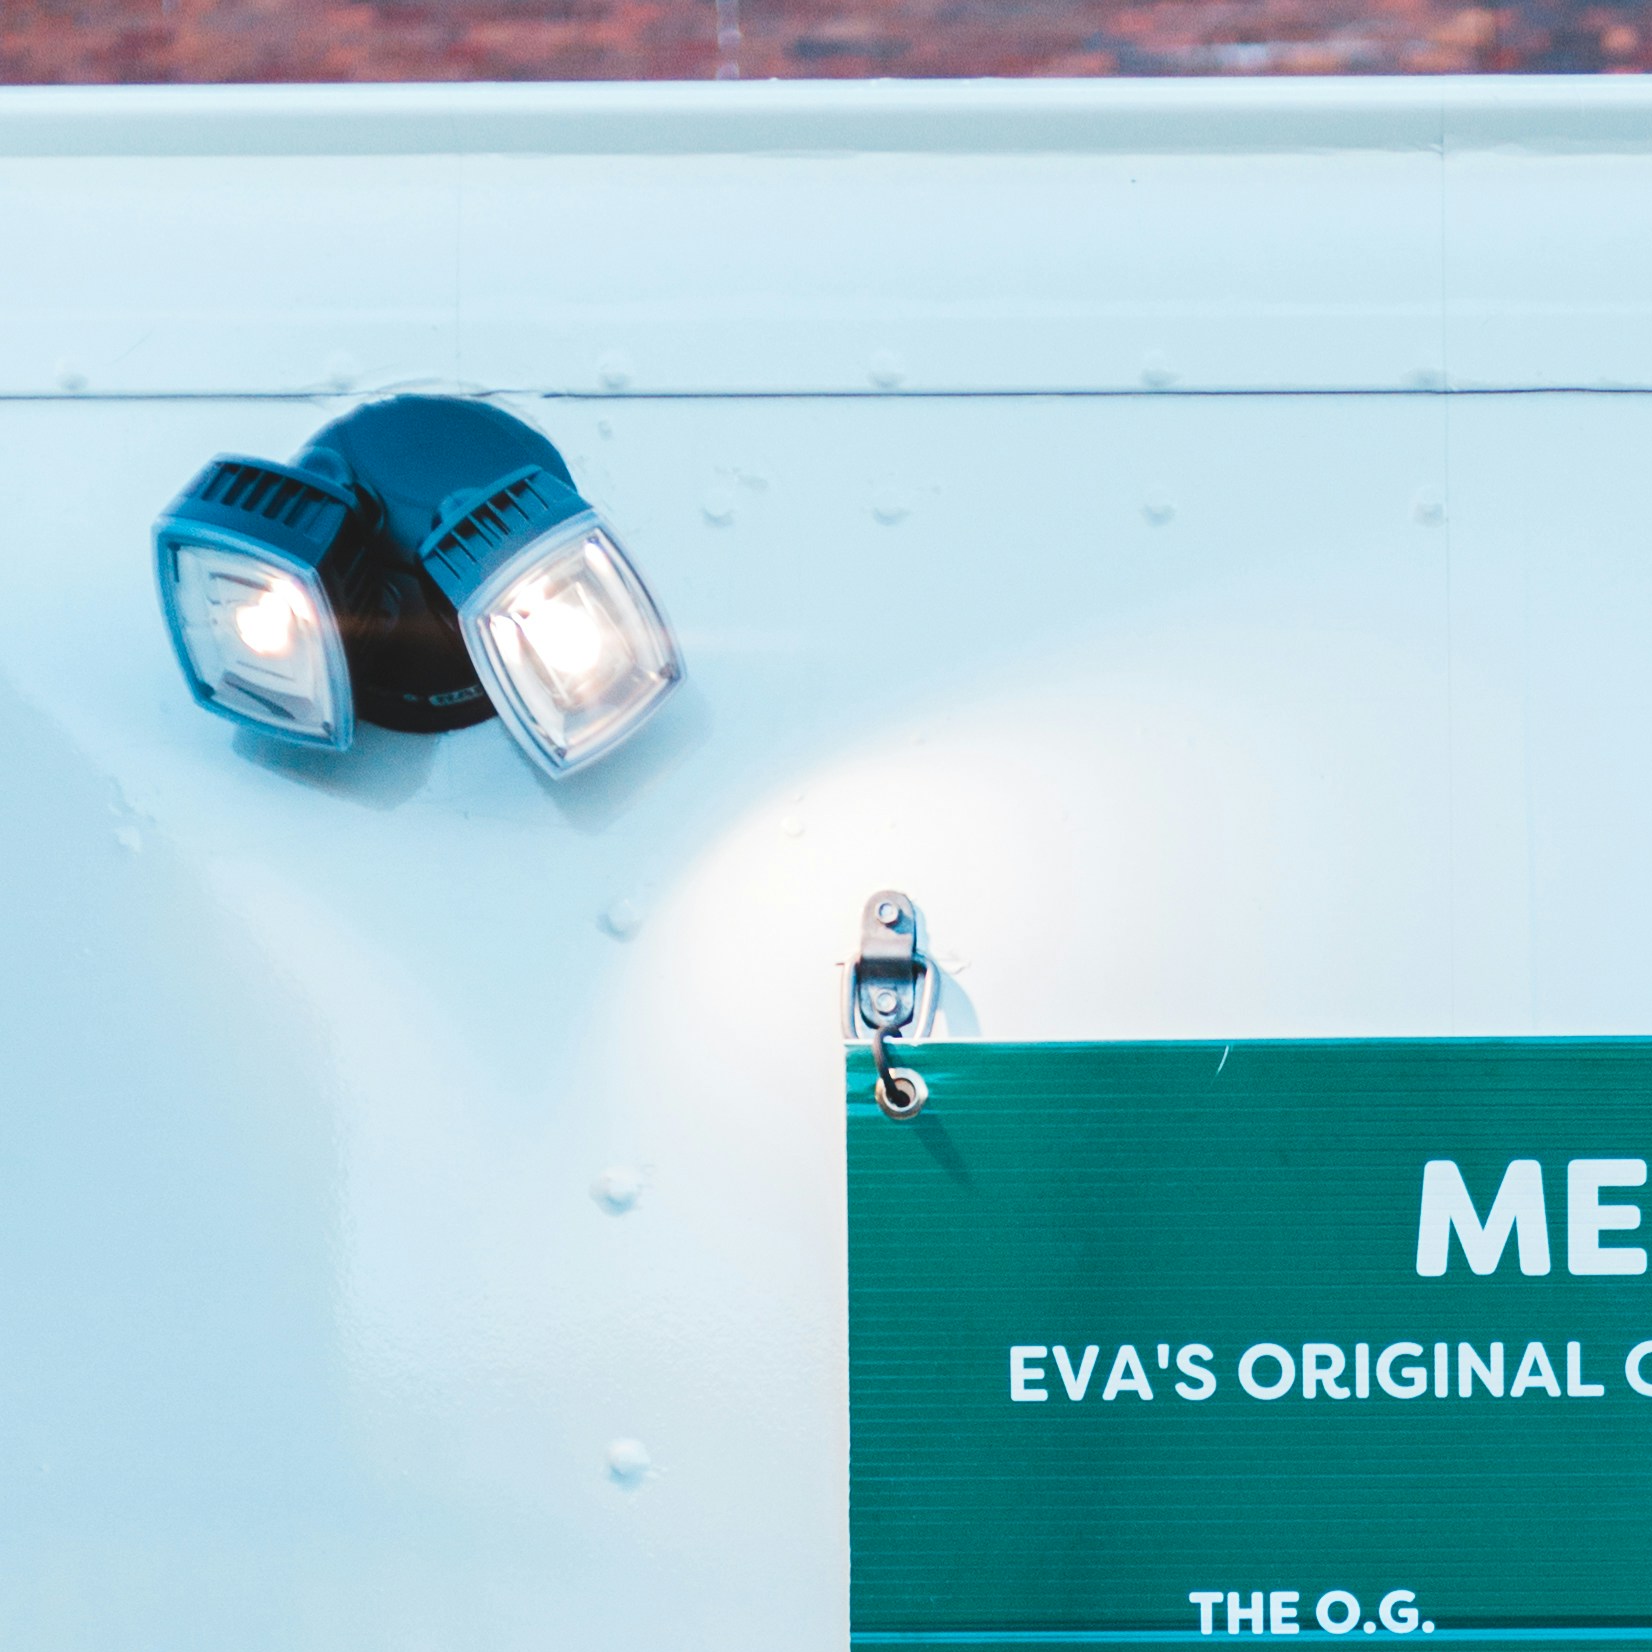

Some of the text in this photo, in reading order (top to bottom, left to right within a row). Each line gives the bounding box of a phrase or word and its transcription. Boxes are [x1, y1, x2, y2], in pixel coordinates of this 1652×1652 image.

[1010, 1344, 1216, 1401] EVA'S
[1237, 1338, 1604, 1401] ORIGINAL
[1189, 1590, 1436, 1635] THE O.G.
